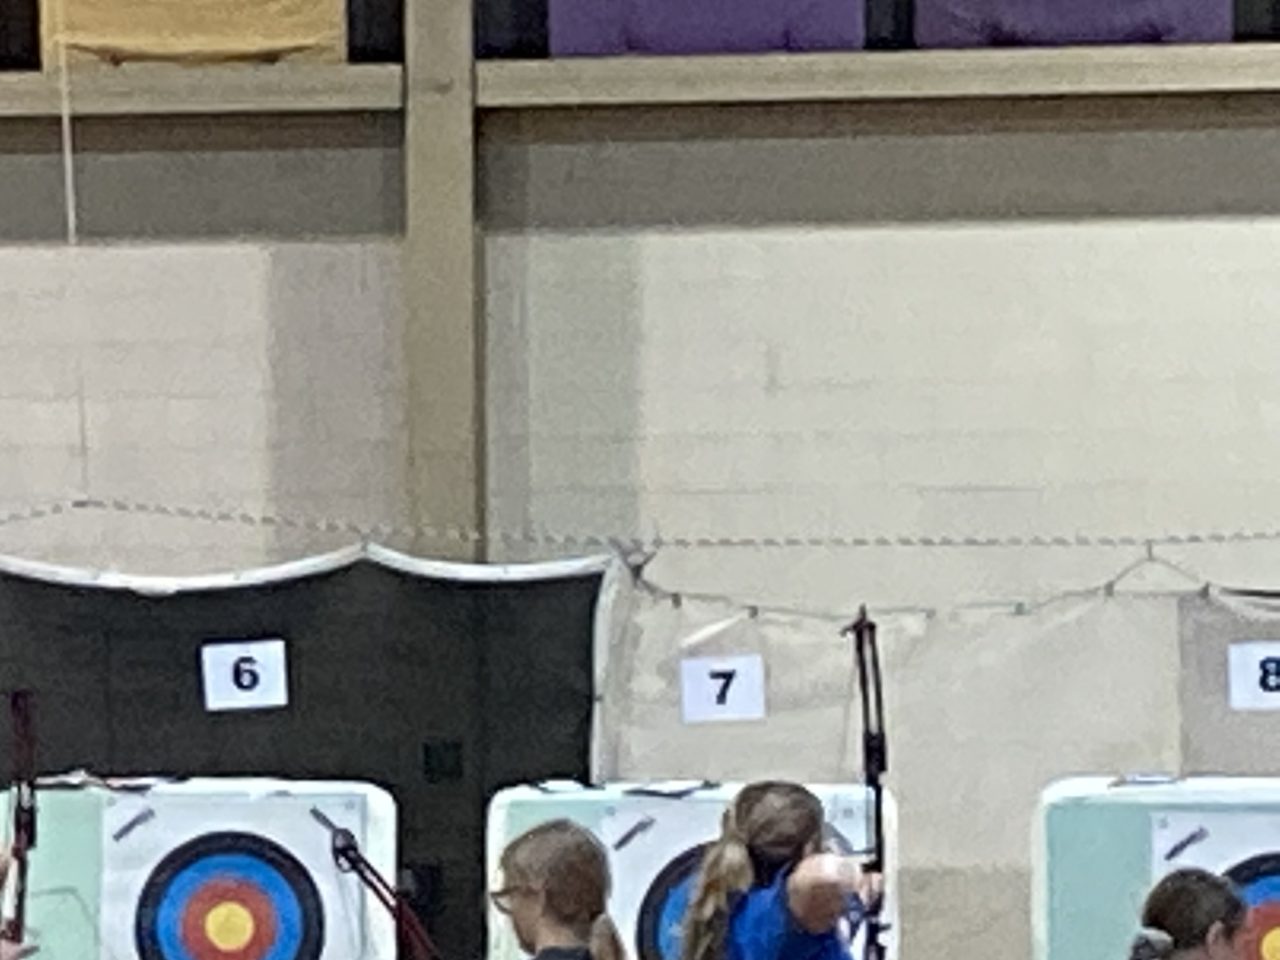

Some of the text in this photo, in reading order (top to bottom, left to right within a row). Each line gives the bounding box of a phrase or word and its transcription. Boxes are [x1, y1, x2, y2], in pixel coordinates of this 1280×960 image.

[232, 656, 260, 692] 6
[709, 669, 736, 705] 7
[1258, 656, 1280, 693] 8
